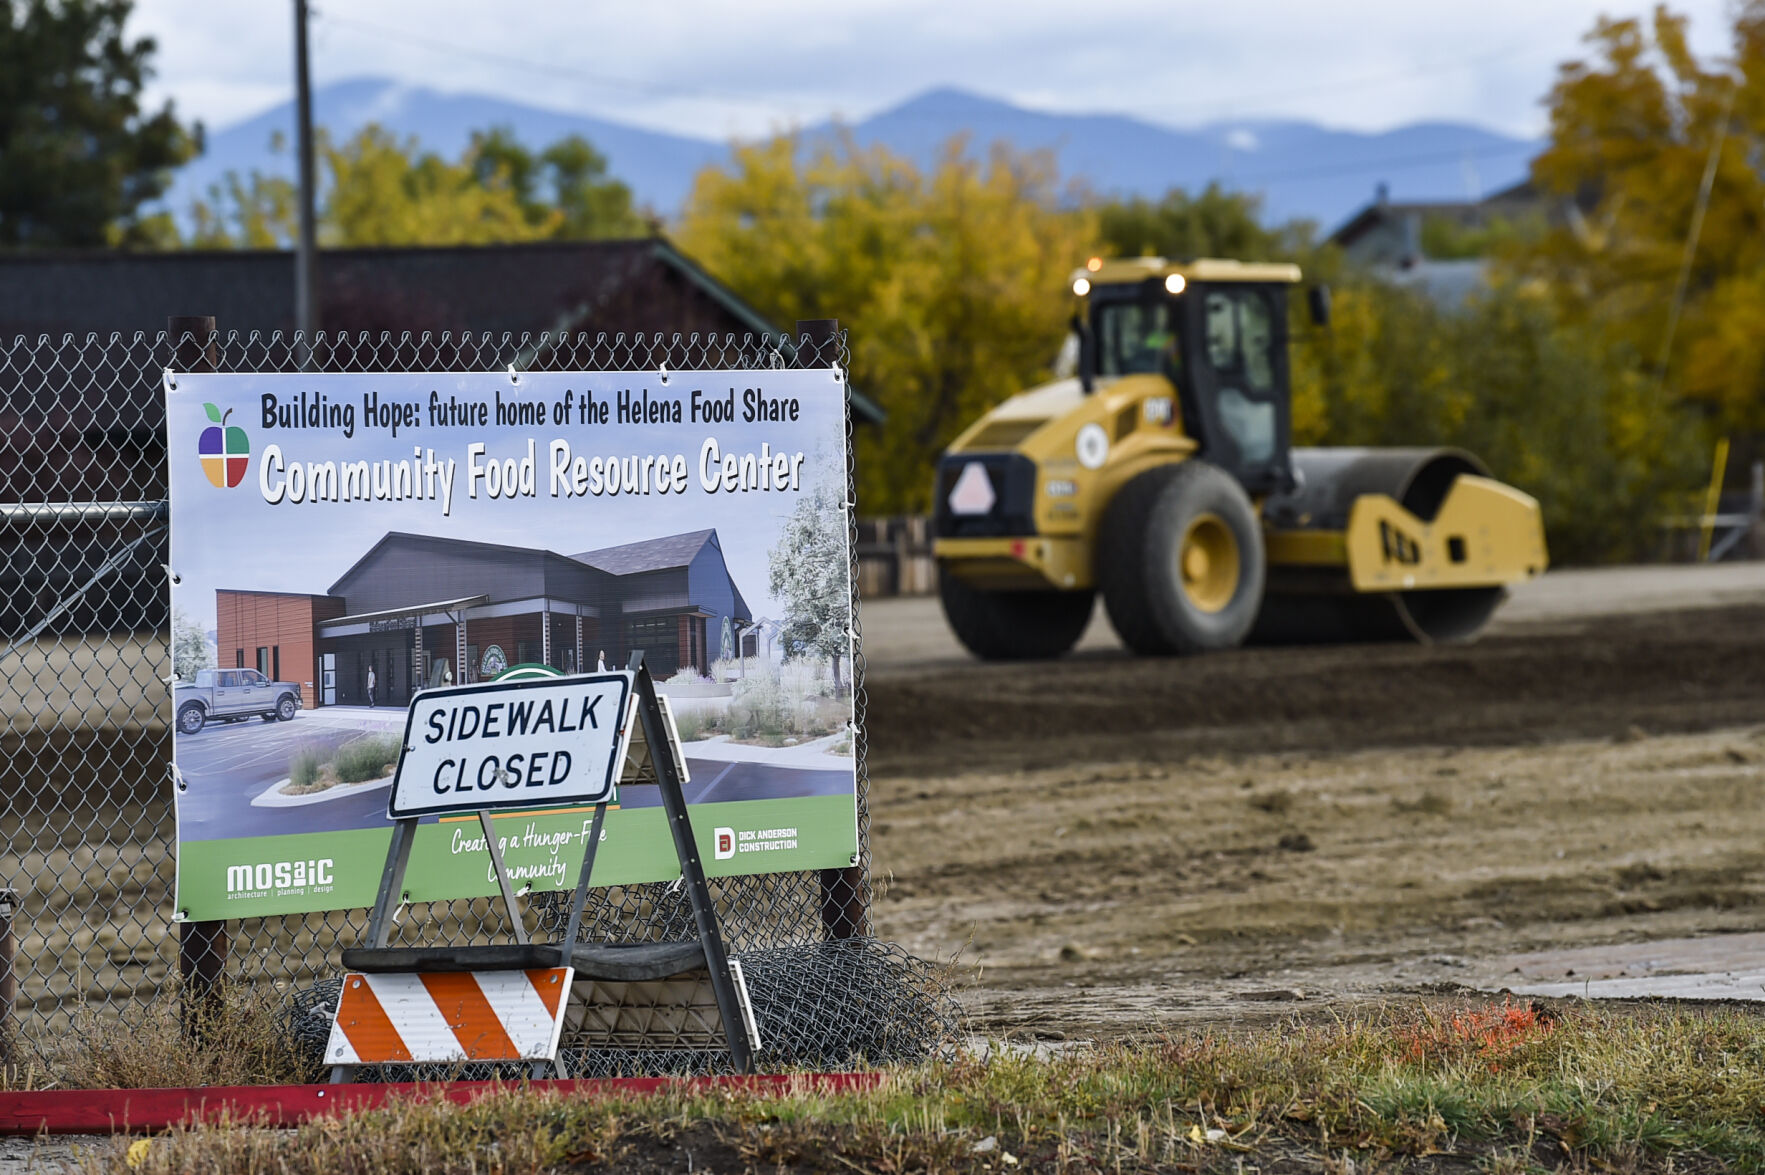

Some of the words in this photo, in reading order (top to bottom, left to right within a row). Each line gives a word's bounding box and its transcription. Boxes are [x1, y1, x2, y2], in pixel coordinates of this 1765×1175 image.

[261, 391, 355, 438] Building
[364, 391, 420, 438] Hope:
[429, 390, 488, 427] future
[496, 390, 546, 426] home
[553, 389, 573, 425] of
[579, 390, 609, 425] the
[617, 389, 682, 424] Helena
[691, 387, 735, 423] Food
[743, 387, 800, 422] Share
[259, 443, 456, 517] Community
[467, 438, 536, 500] Food
[549, 438, 688, 499] Resource
[699, 436, 804, 494] Center
[425, 694, 604, 744] SIDEWALK
[433, 750, 572, 794] CLOSED
[510, 836, 520, 848] a
[523, 819, 608, 855] Hunger-Fe
[738, 830, 757, 841] DICK
[757, 827, 798, 839] ANDERSON
[738, 840, 798, 853] CONSTRUCTION
[488, 855, 566, 886] Cmmunity
[227, 890, 268, 900] architecture
[277, 887, 305, 897] planning
[313, 885, 334, 894] design
